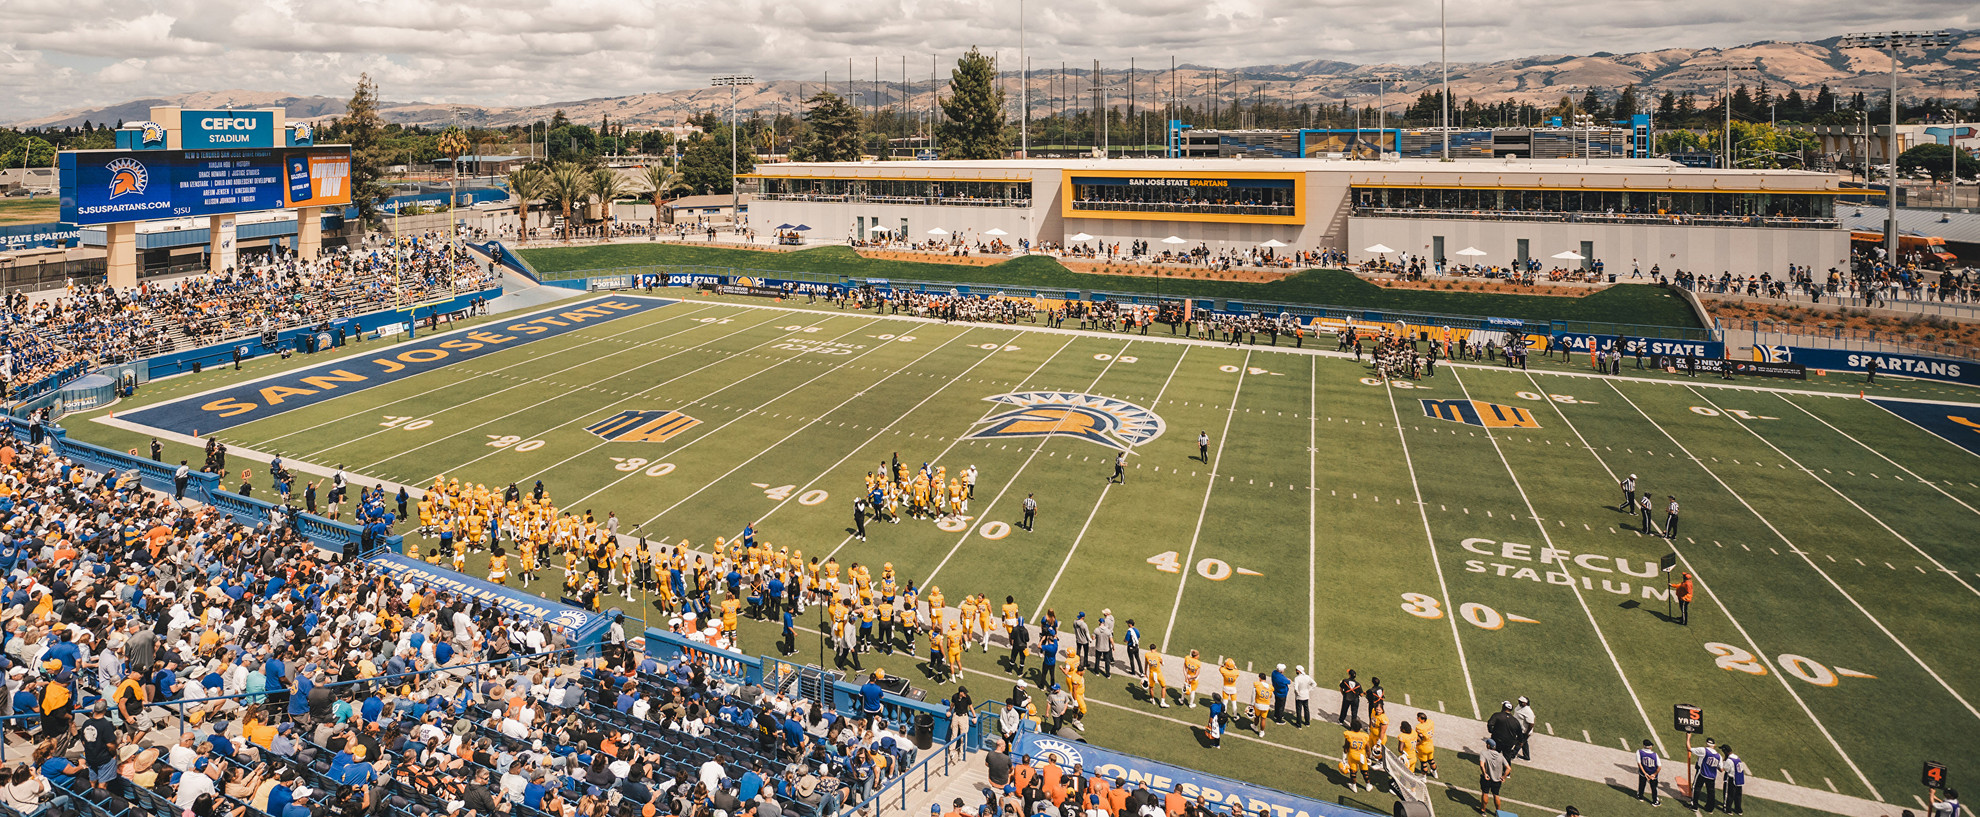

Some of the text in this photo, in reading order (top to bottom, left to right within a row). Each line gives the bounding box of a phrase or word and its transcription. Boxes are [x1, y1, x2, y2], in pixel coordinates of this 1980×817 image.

[201, 117, 257, 130] CEFCU
[209, 134, 250, 143] STADIUM
[320, 177, 342, 197] NOW
[1146, 177, 1165, 186] JOSÉ
[78, 201, 171, 214] SJSUSPARTANS.COM
[173, 207, 191, 215] SJSU
[0, 230, 81, 245] STATE SPARTANS
[667, 274, 692, 284] JOSÉ
[783, 282, 828, 293] SPRTANS
[1602, 338, 1647, 353] JSÉ
[1652, 342, 1705, 357] STATE
[201, 300, 642, 418] SAN JOSÉ STATE
[1848, 354, 1961, 378] SPARTANS
[614, 457, 676, 477] 30
[763, 484, 829, 506] 40
[1146, 551, 1233, 581] 40
[1460, 537, 1659, 578] CEFCU
[1465, 560, 1679, 603] STADIUM
[478, 590, 551, 618] NATION
[1401, 592, 1504, 630] 30
[1704, 642, 1839, 687] 20
[1677, 717, 1701, 726] YARD
[1689, 709, 1701, 720] 5
[1352, 740, 1363, 750] 67
[1020, 769, 1027, 778] 4
[1100, 763, 1173, 796] ONE
[1927, 767, 1942, 782] 4
